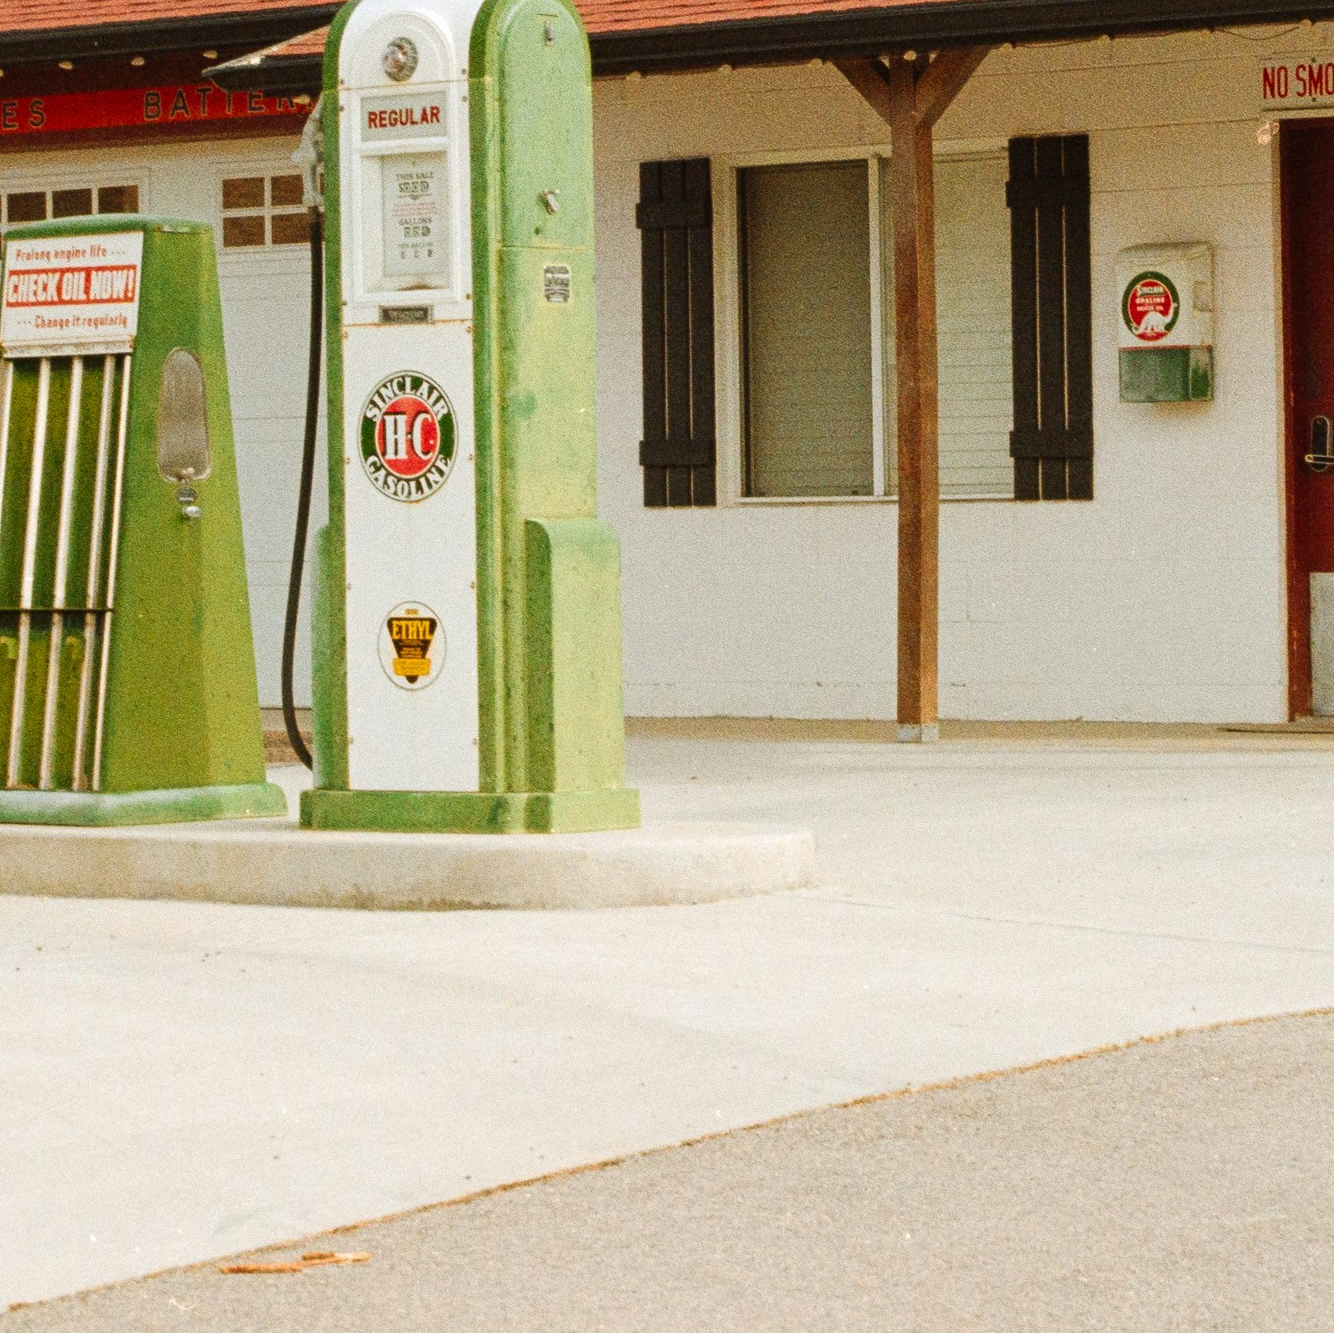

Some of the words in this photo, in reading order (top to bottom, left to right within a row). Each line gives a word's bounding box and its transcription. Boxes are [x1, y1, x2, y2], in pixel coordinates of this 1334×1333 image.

[1262, 66, 1289, 99] NO
[367, 105, 440, 129] REGULAR
[15, 248, 51, 262] Prolong
[54, 248, 87, 263] engine
[90, 243, 107, 258] life
[7, 272, 61, 303] CHECK
[61, 270, 87, 301] OIL
[35, 314, 70, 330] Change
[365, 376, 448, 422] SINCLAIR
[365, 454, 451, 498] GASOLINE
[392, 620, 434, 640] ETHYL
